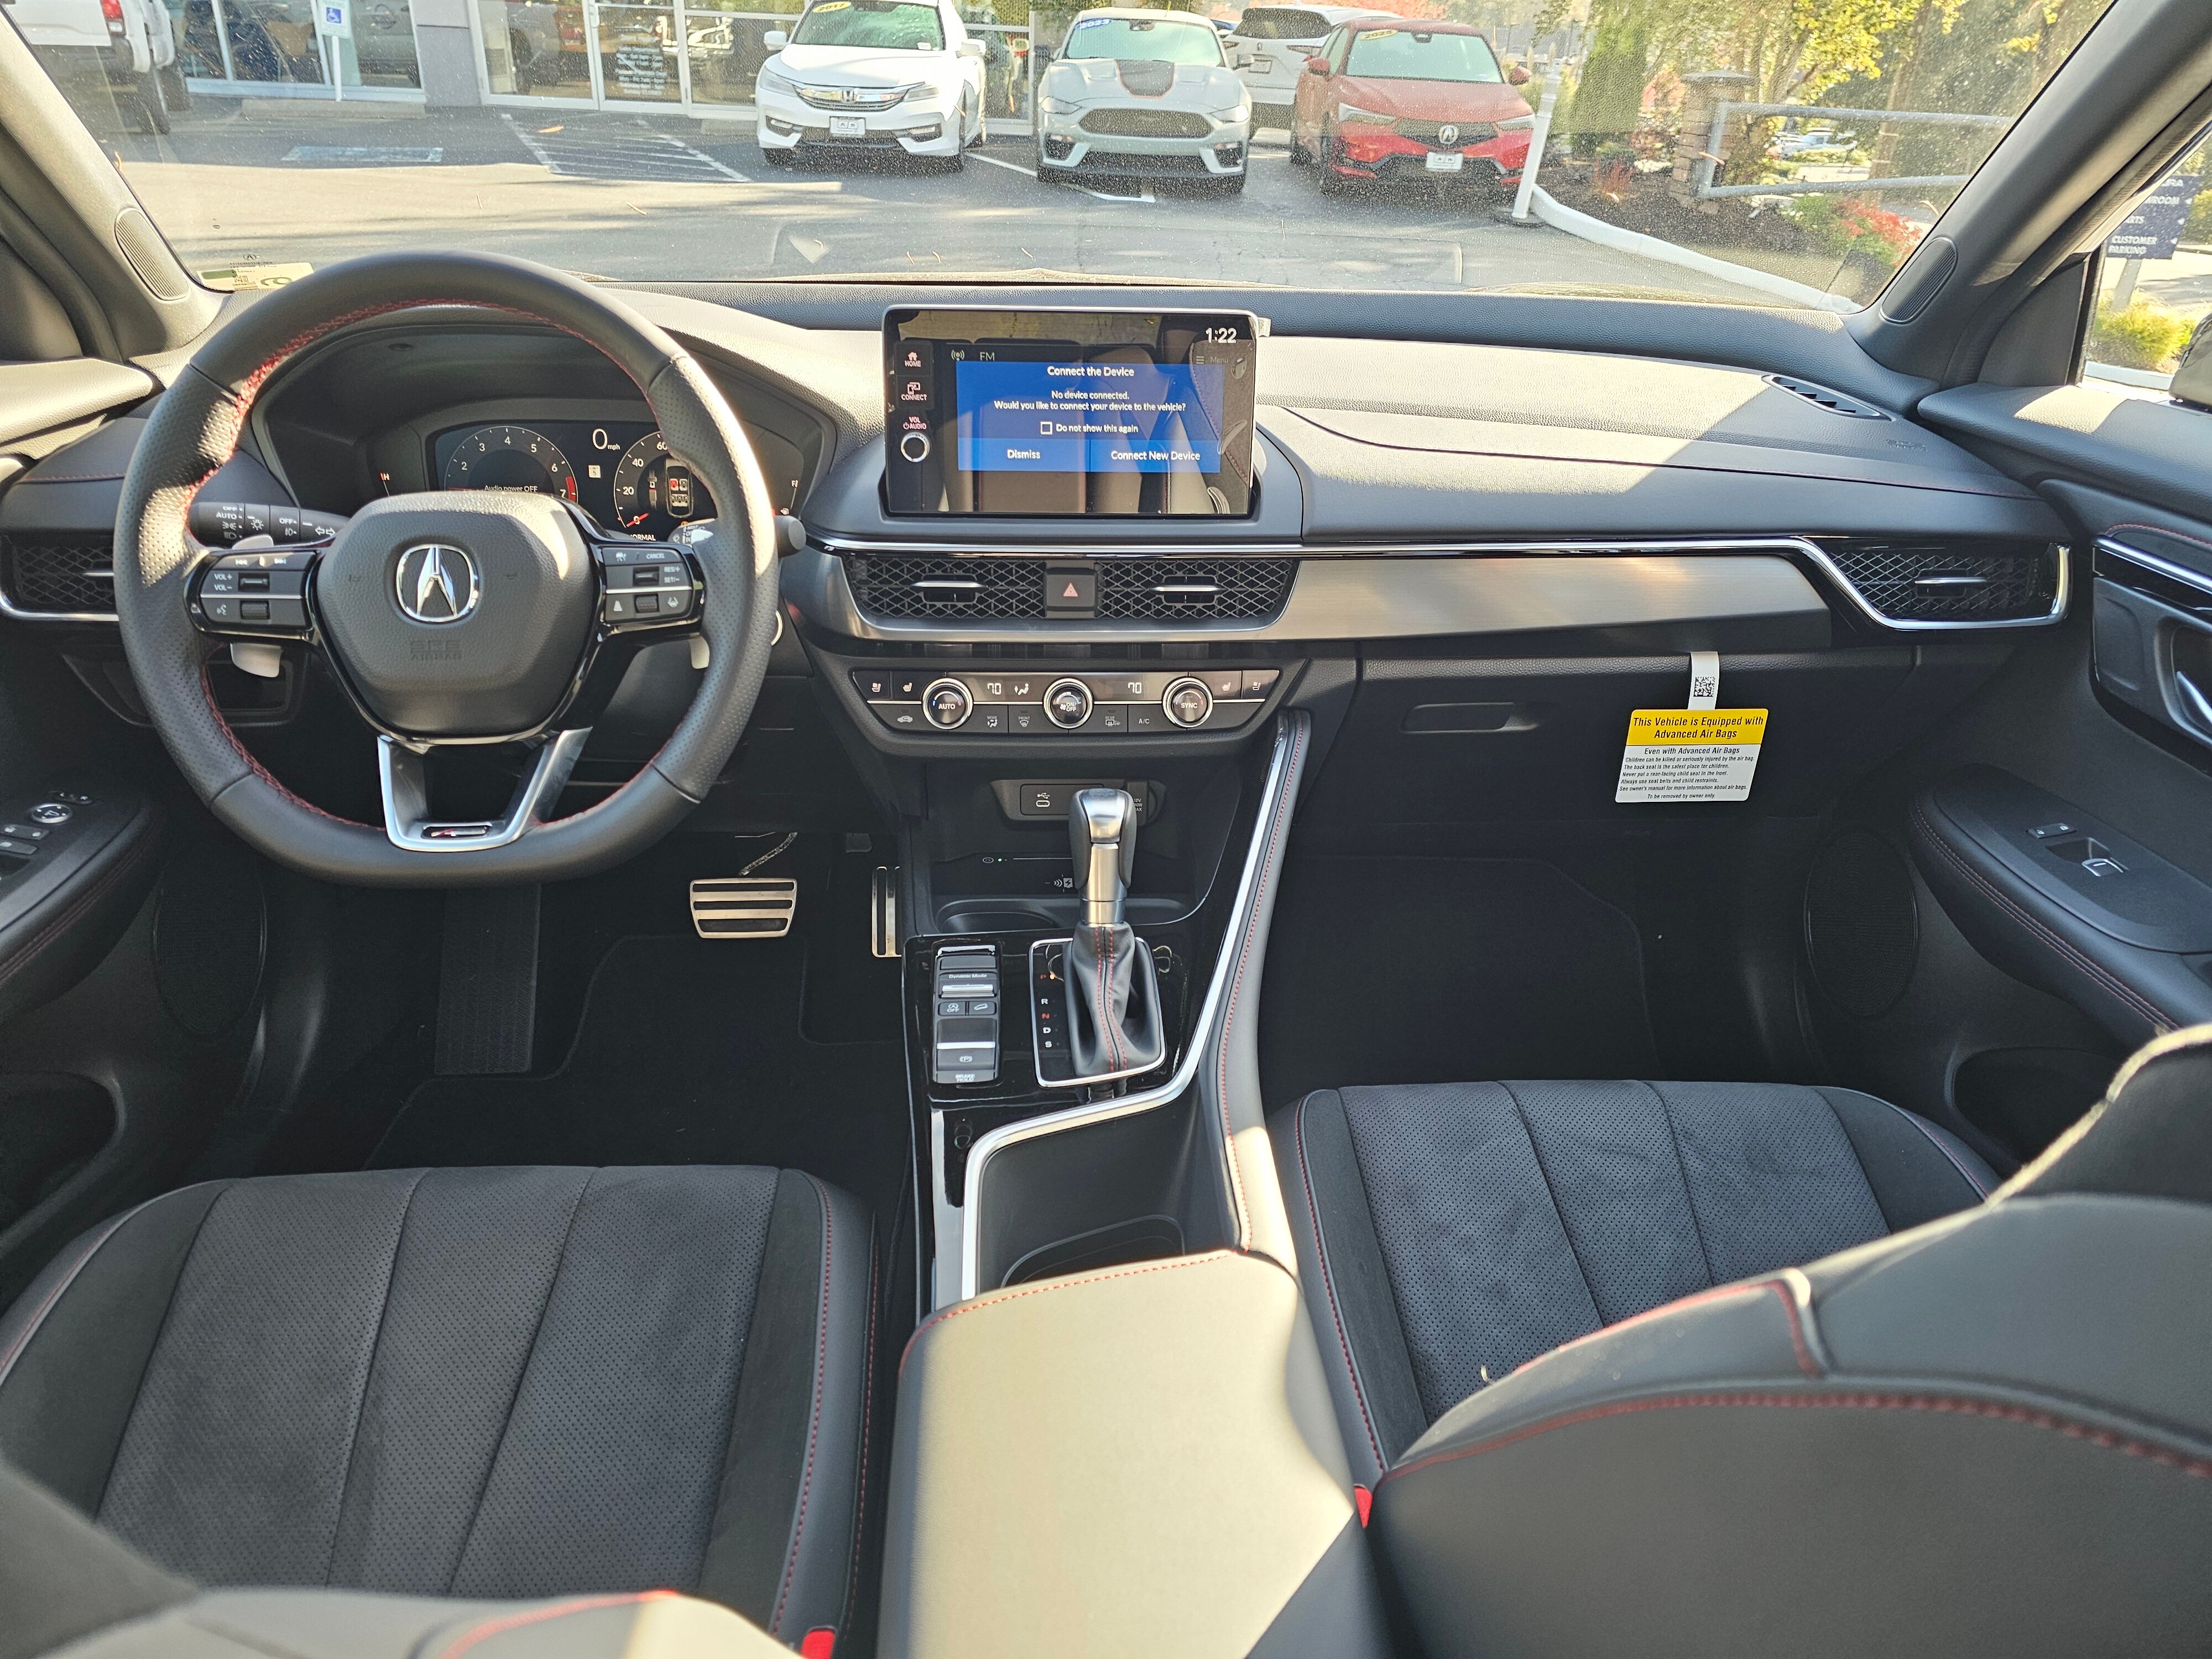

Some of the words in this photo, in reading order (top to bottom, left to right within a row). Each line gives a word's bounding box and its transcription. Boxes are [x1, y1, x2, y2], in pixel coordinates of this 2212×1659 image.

[2112, 236, 2158, 245] CUSTOMER
[2107, 245, 2147, 254] PARKING
[1206, 327, 1237, 343] 1:22
[979, 352, 995, 361] FM
[1047, 366, 1086, 377] Connect
[1087, 366, 1102, 376] the
[1103, 367, 1135, 377] Device
[1051, 390, 1063, 399] No
[1064, 390, 1088, 399] device
[1089, 391, 1130, 400] connected.
[994, 400, 1019, 410] Would
[1020, 403, 1035, 411] you
[1036, 401, 1049, 410] like
[1050, 402, 1058, 410] to
[1060, 402, 1089, 410] connect
[1090, 403, 1108, 412] your
[1109, 403, 1133, 411] device
[1134, 403, 1142, 411] to
[1143, 403, 1156, 411] the
[1157, 403, 1186, 411] vehicle?
[1056, 424, 1068, 432] Do
[1068, 424, 1082, 432] not
[1082, 424, 1103, 432] show
[1103, 424, 1118, 433] this
[1118, 424, 1139, 434] again
[504, 436, 511, 445] 4
[592, 428, 608, 450] 0
[479, 443, 485, 451] 3
[531, 444, 537, 453] 5
[656, 441, 668, 451] 60
[1007, 449, 1041, 459] Dismiss
[1111, 450, 1147, 460] Connect
[1149, 450, 1169, 461] New
[1171, 451, 1201, 461] Device
[461, 462, 468, 470] 2
[551, 463, 558, 472] 6
[632, 458, 644, 467] 40
[560, 489, 566, 498] 7
[623, 486, 634, 495] 20
[987, 682, 1001, 695] 70
[1128, 682, 1142, 694] 70
[1634, 717, 1652, 726] This
[1655, 717, 1687, 726] Vehicle
[1691, 717, 1698, 726] is
[1701, 717, 1743, 727] Equipped
[1745, 717, 1764, 725] with
[1654, 729, 1698, 738] Advanced
[1700, 729, 1713, 738] Air
[1715, 729, 1738, 739] Bags
